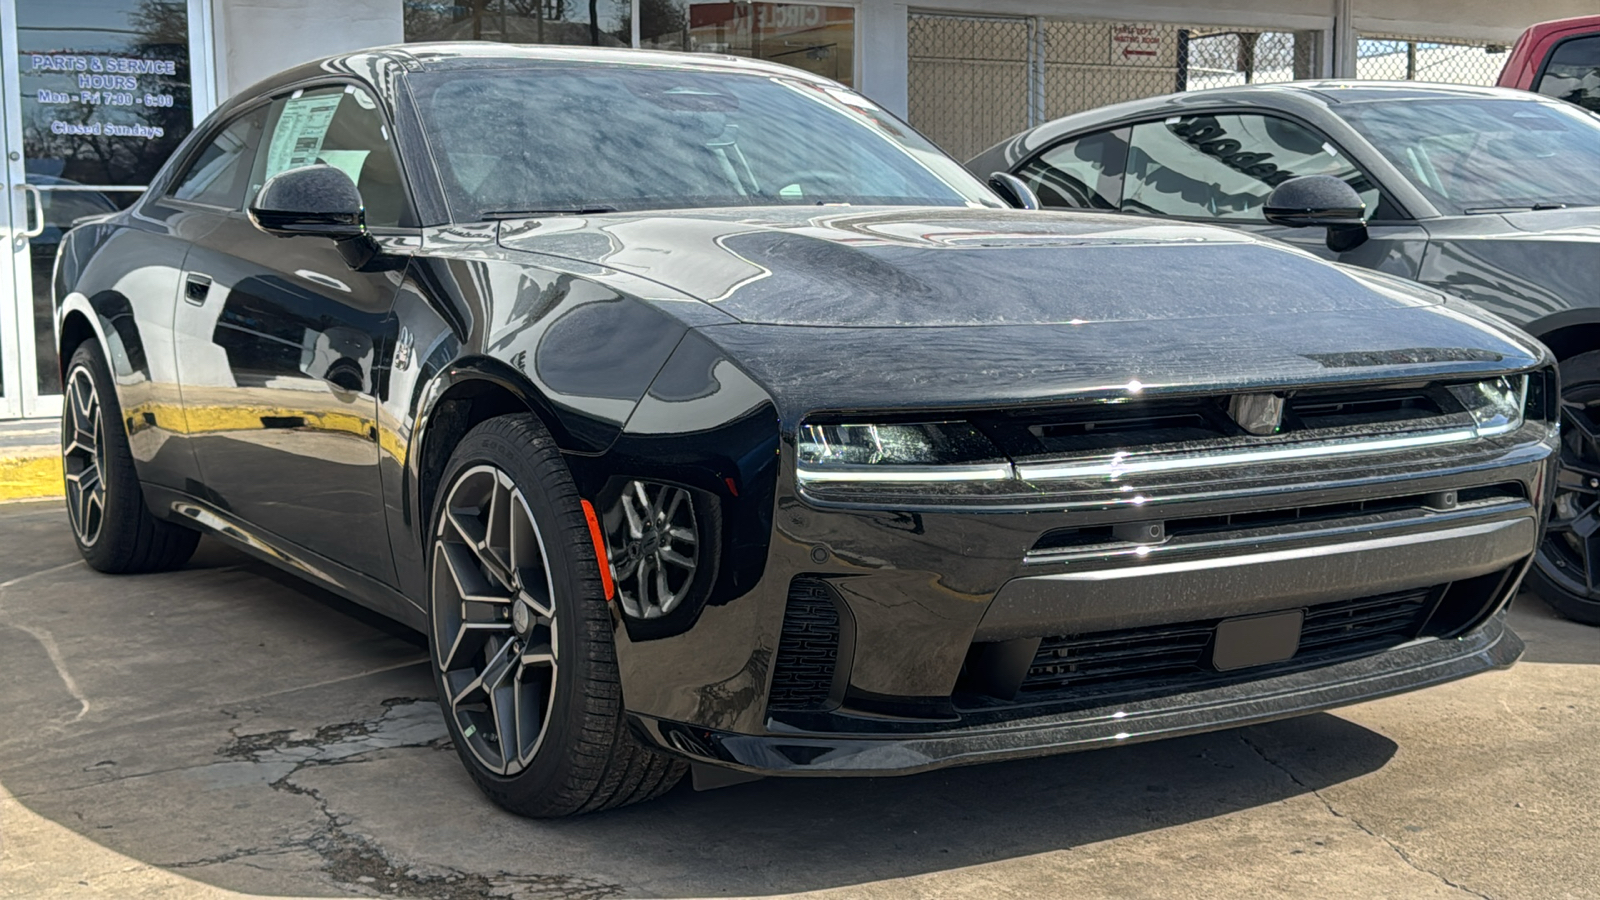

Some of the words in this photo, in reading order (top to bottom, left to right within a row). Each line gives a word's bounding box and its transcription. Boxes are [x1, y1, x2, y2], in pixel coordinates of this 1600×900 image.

[32, 55, 87, 71] PARTS
[90, 56, 104, 72] &
[107, 57, 176, 75] SERVICE
[78, 74, 138, 90] HOURS
[37, 89, 70, 104] Mon
[80, 91, 101, 104] Fri
[103, 92, 133, 106] 7:00
[144, 93, 174, 108] 6:00
[51, 120, 101, 135] Closed
[103, 121, 165, 140] Sundays
